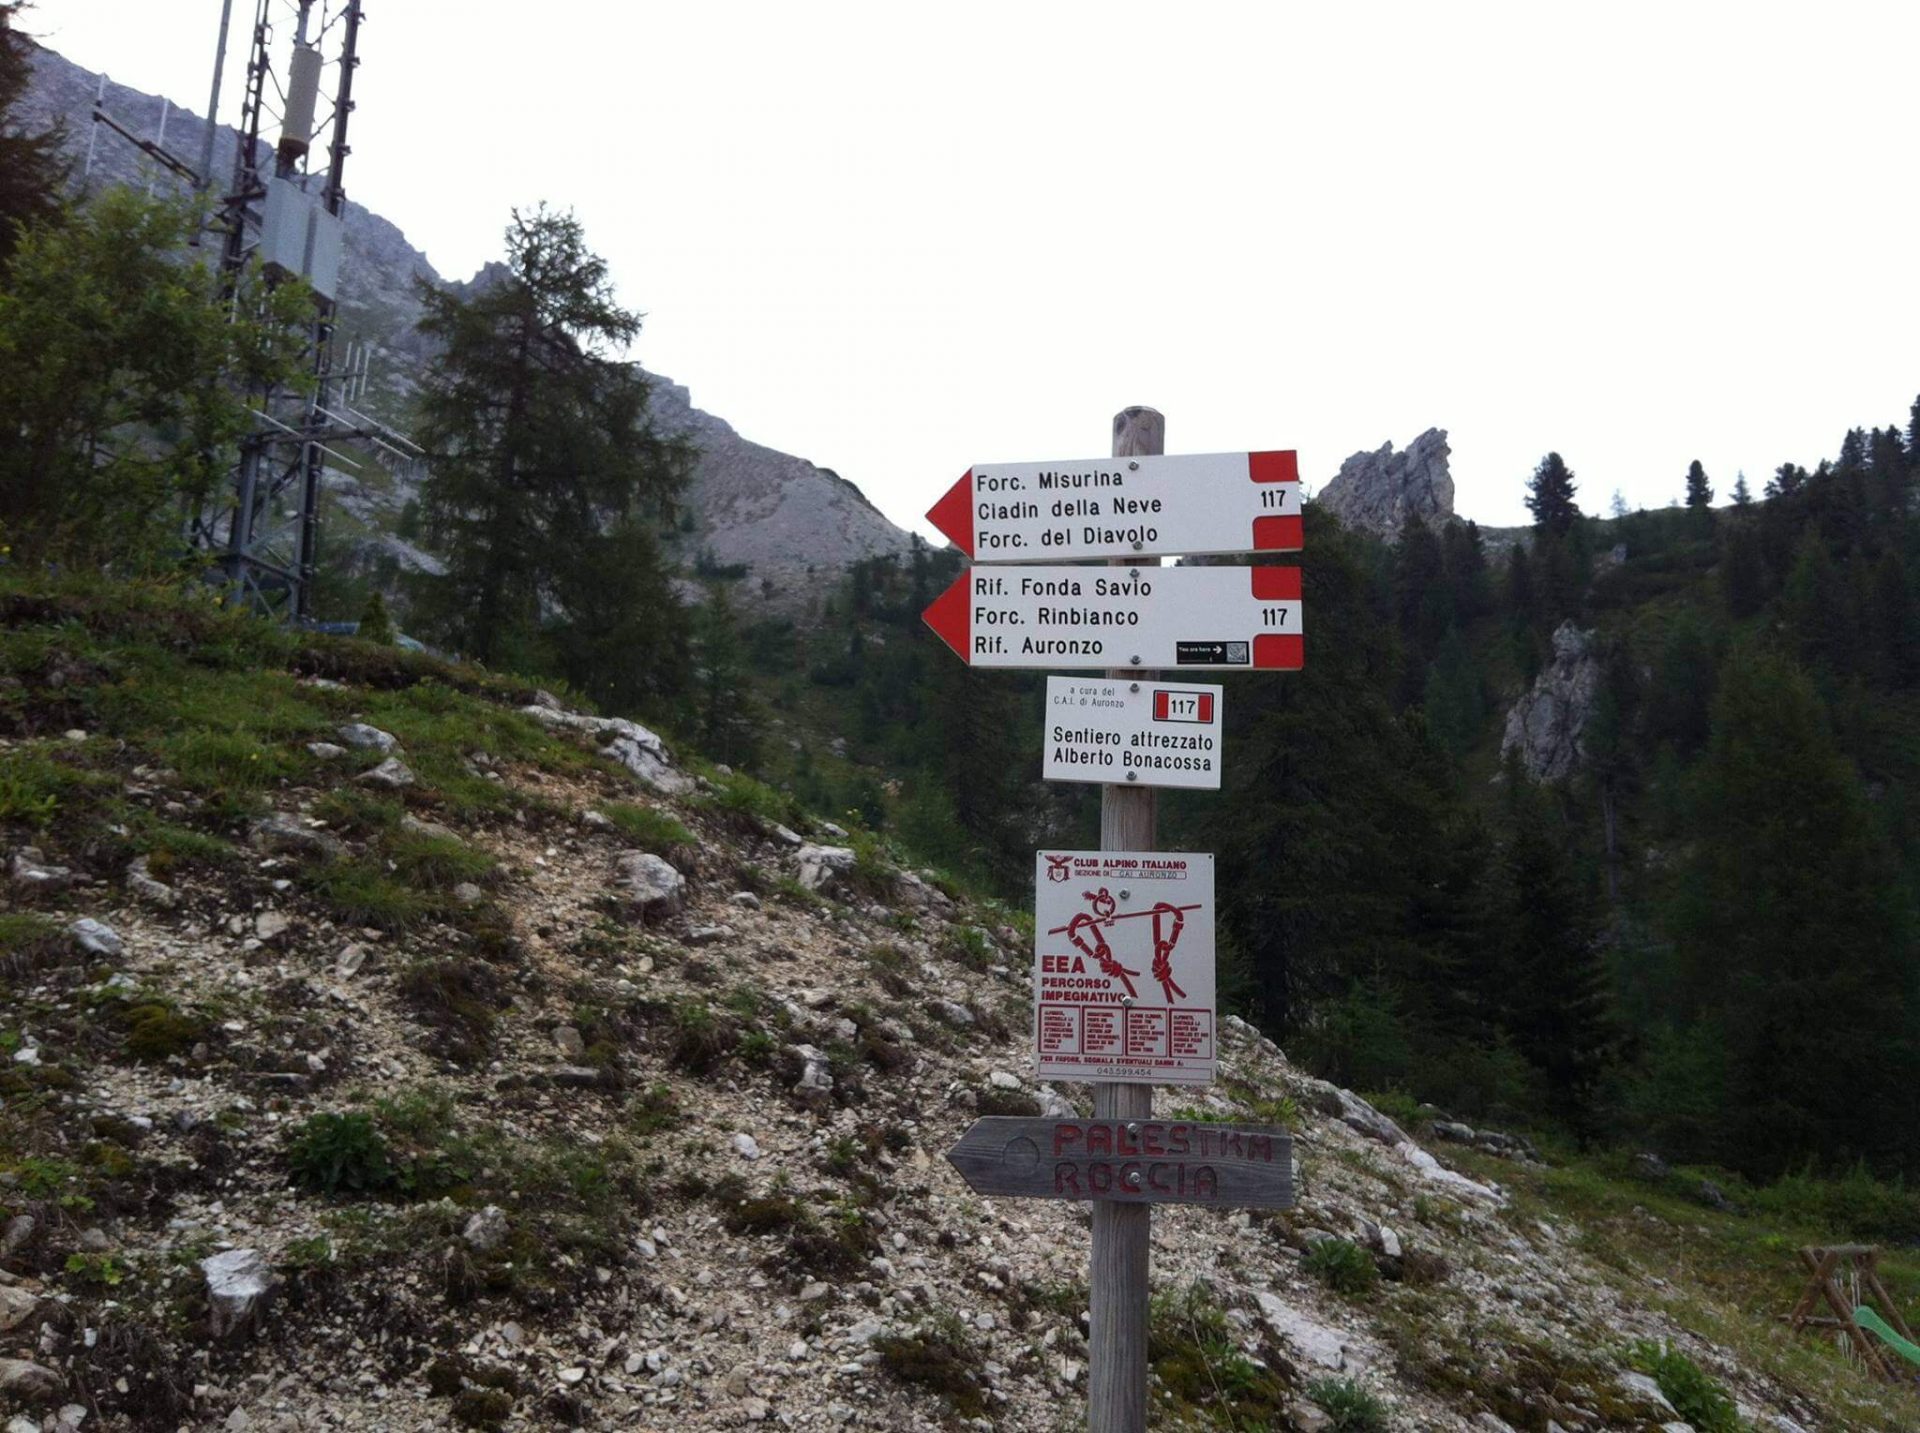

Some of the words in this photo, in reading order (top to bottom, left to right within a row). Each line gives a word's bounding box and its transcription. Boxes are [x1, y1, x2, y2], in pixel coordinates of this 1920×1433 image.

[977, 474, 1025, 491] Forc.
[1039, 470, 1123, 489] Misurina
[1261, 491, 1285, 508] 117
[978, 502, 1038, 520] Ciadin
[1052, 499, 1100, 516] della
[1114, 497, 1162, 514] Neve
[979, 531, 1028, 549] Forc.
[1042, 528, 1071, 546] del
[1084, 526, 1158, 544] Diavolo
[975, 579, 1008, 596] Rif.
[1022, 579, 1081, 596] Fonda
[1095, 579, 1152, 596] Savio
[975, 608, 1024, 624] Forc.
[1038, 608, 1139, 625] Rinbianco
[1262, 609, 1287, 626] 117
[975, 637, 1008, 654] Rif.
[1022, 637, 1103, 654] Auronzo
[1079, 687, 1098, 695] cura
[1102, 688, 1114, 696] del
[1092, 698, 1125, 708] Auronzo
[1171, 700, 1195, 714] 117
[1054, 727, 1121, 745] Sentiero
[1131, 731, 1213, 750] attrezzato
[1054, 748, 1113, 766] Alberto
[1123, 751, 1211, 771] Bonacossa
[1074, 859, 1098, 867] CLUB
[1103, 860, 1139, 868] ALPINO
[1142, 861, 1187, 869] ITALIANO
[1042, 955, 1085, 973] EEA
[1042, 978, 1111, 988] PERCORSO
[1054, 1162, 1217, 1197] ROCCIA
